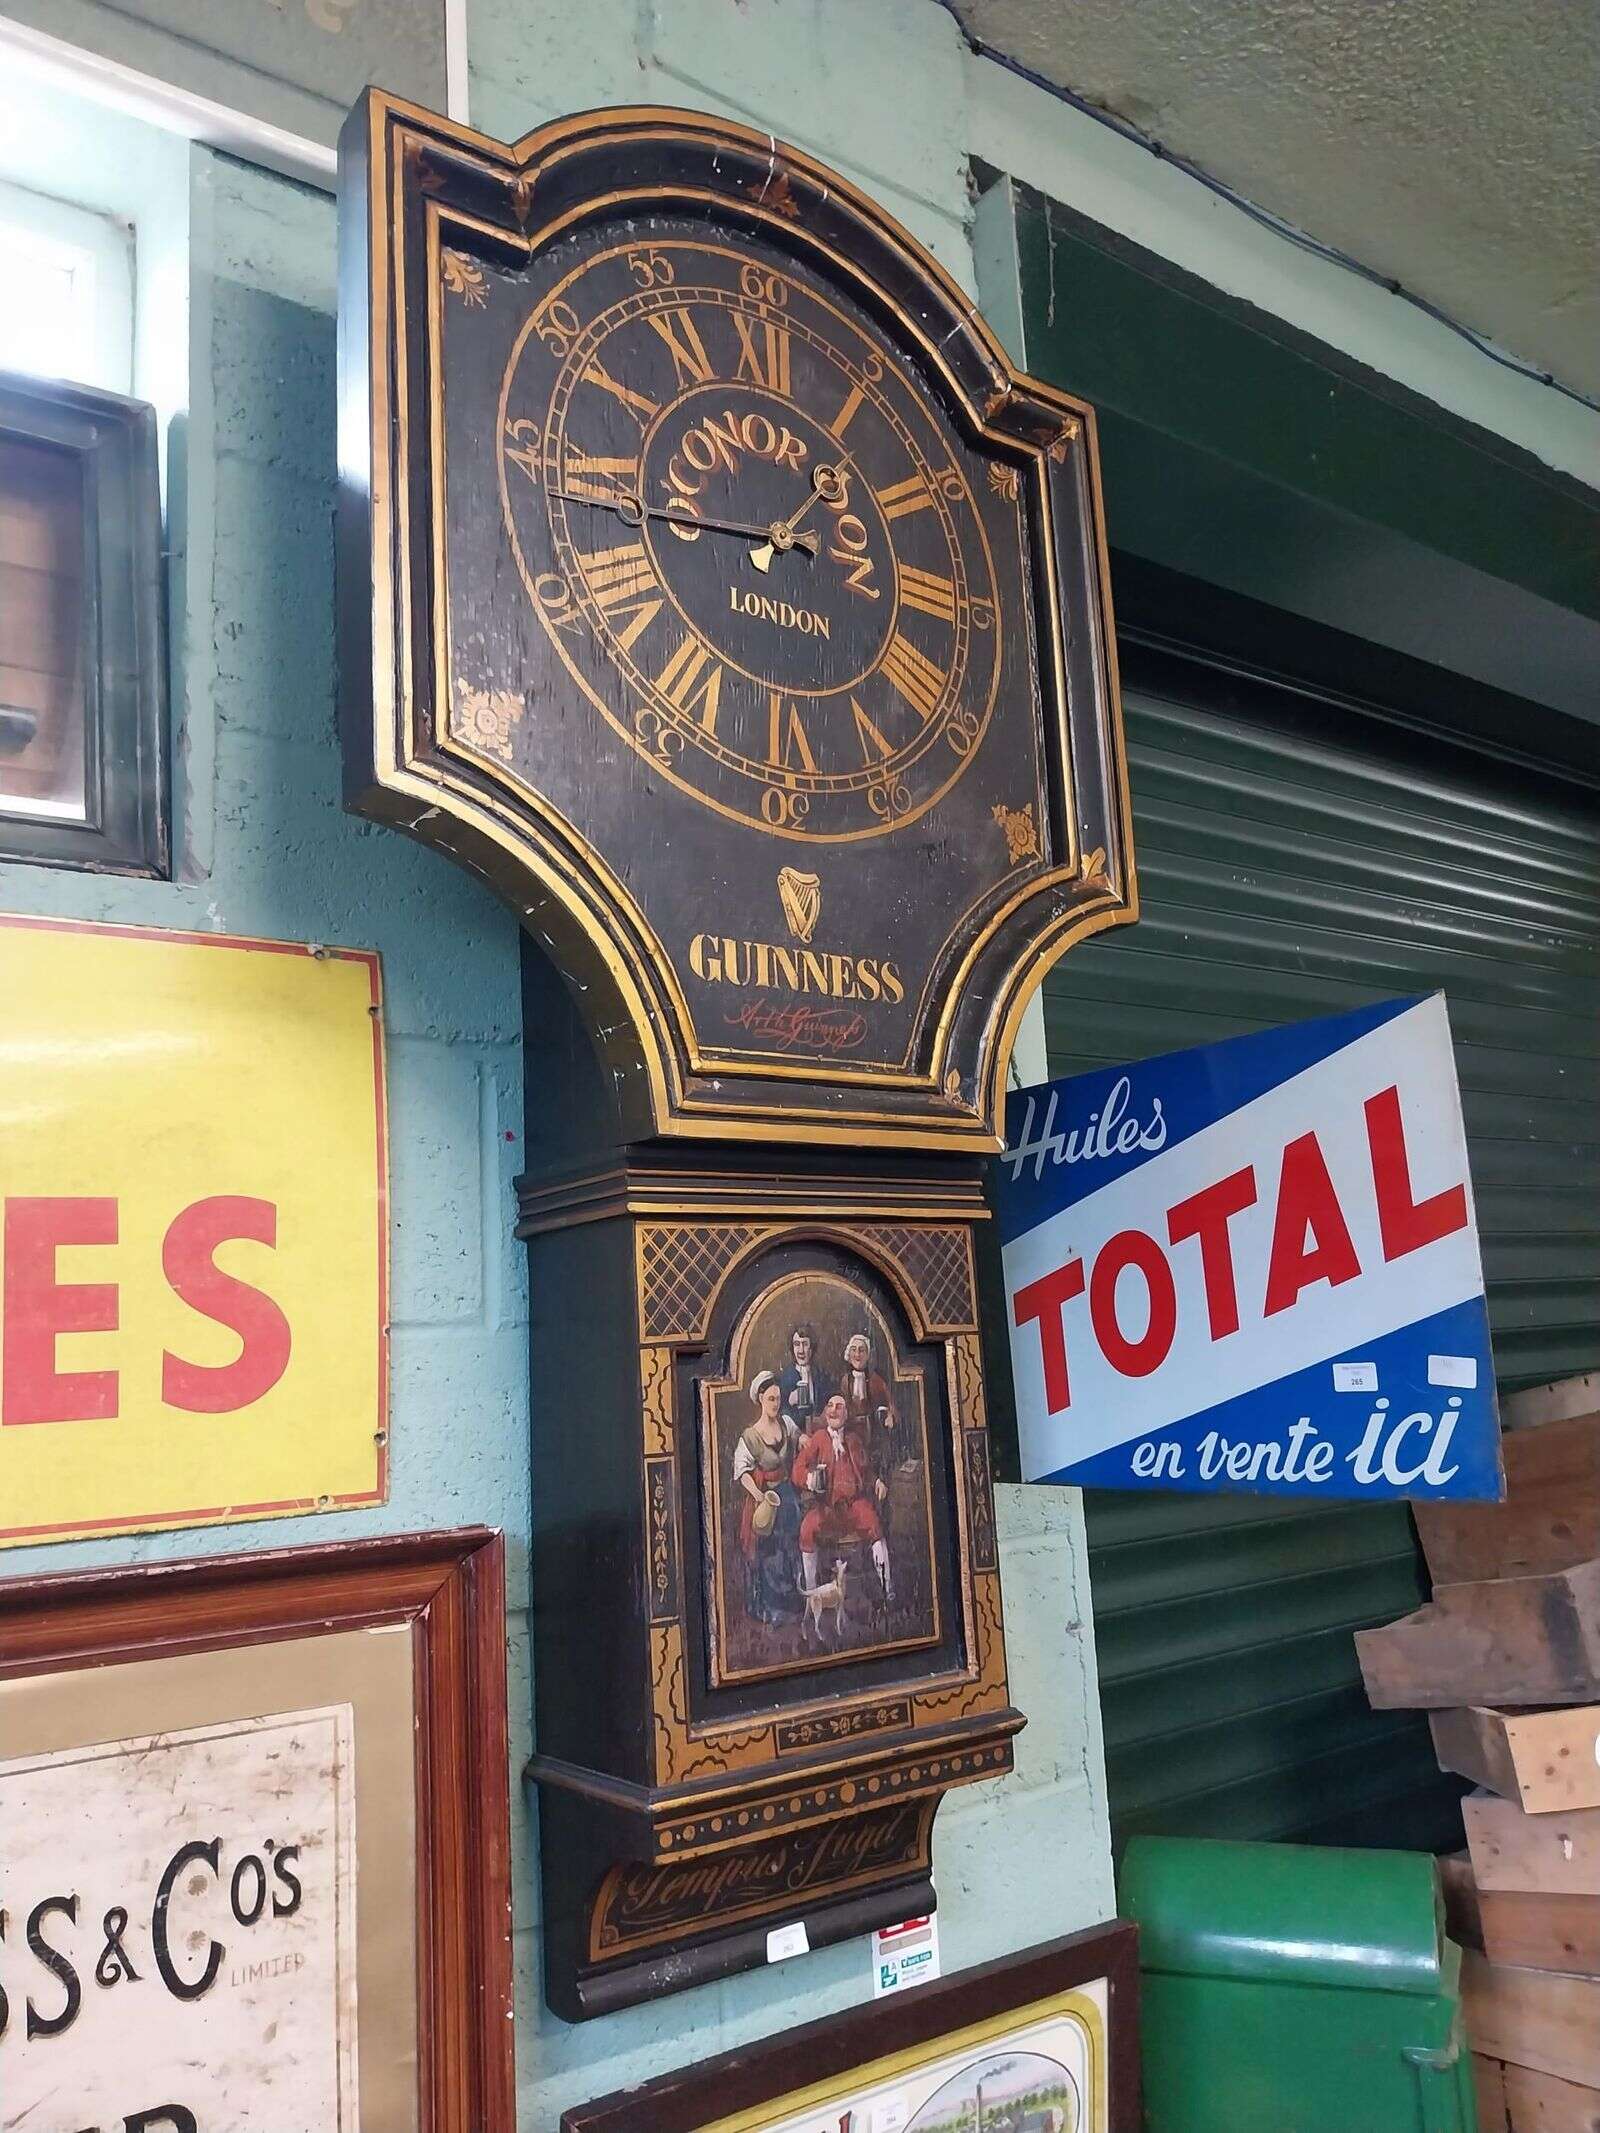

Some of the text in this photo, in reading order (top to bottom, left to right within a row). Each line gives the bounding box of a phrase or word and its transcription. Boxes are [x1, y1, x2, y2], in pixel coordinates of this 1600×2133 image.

[627, 249, 675, 288] 55
[740, 264, 788, 306] 60
[535, 300, 581, 358] 50
[641, 307, 720, 392] XI
[727, 310, 794, 399] XII
[579, 353, 663, 441] X
[862, 353, 883, 382] 5
[505, 418, 542, 485] 45
[935, 466, 965, 501] 10
[872, 474, 938, 523] II
[534, 573, 584, 636] 40
[573, 538, 666, 657] VIII
[729, 586, 831, 640] LONDON
[898, 557, 956, 629] III
[969, 595, 995, 630] 15
[650, 631, 723, 740] VII
[634, 708, 684, 767] 35
[764, 691, 823, 775] VI
[850, 695, 898, 768] V
[946, 703, 979, 756] 20
[761, 787, 810, 831] 30
[867, 777, 912, 821] 25
[688, 933, 905, 1004] GUINNESS
[1001, 1076, 1167, 1181] Huiles
[1012, 1083, 1469, 1417] TOTAL
[1, 1194, 292, 1426] ES
[1130, 1396, 1463, 1486] en vente ici
[0, 1893, 82, 2042] S
[95, 1905, 144, 1989] &
